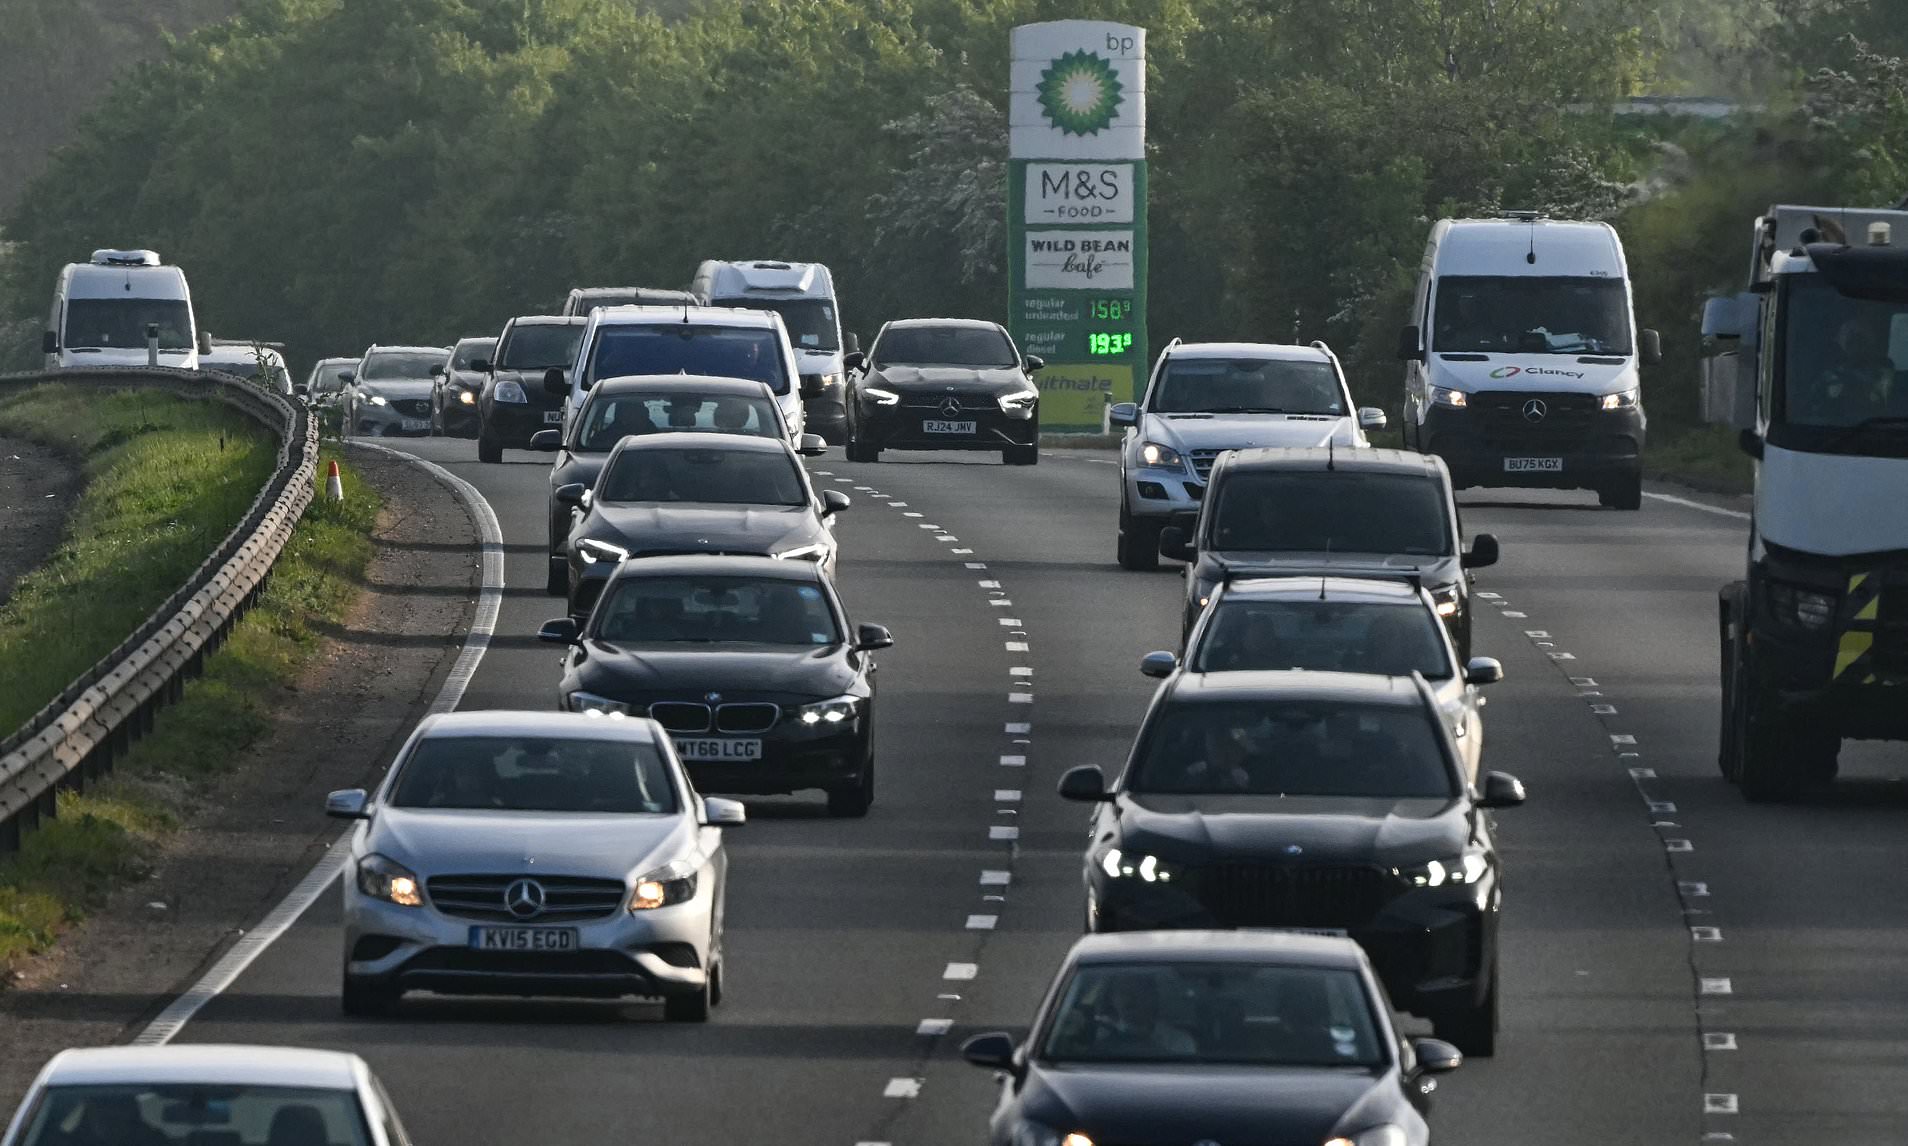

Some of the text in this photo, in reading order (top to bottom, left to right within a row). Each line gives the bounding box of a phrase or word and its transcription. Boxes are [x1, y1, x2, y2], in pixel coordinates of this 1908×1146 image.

[1106, 32, 1134, 56] bp
[1042, 170, 1119, 200] M&S
[1058, 206, 1102, 218] FOOD
[1031, 240, 1130, 253] WILD BEAN
[1024, 299, 1065, 310] regular
[1025, 311, 1079, 320] unleaded
[1024, 331, 1066, 344] regular
[1525, 367, 1584, 379] Clancy
[1509, 459, 1559, 470] BU75 KGX
[723, 741, 755, 757] LCG
[485, 929, 571, 949] KV15 EGD
